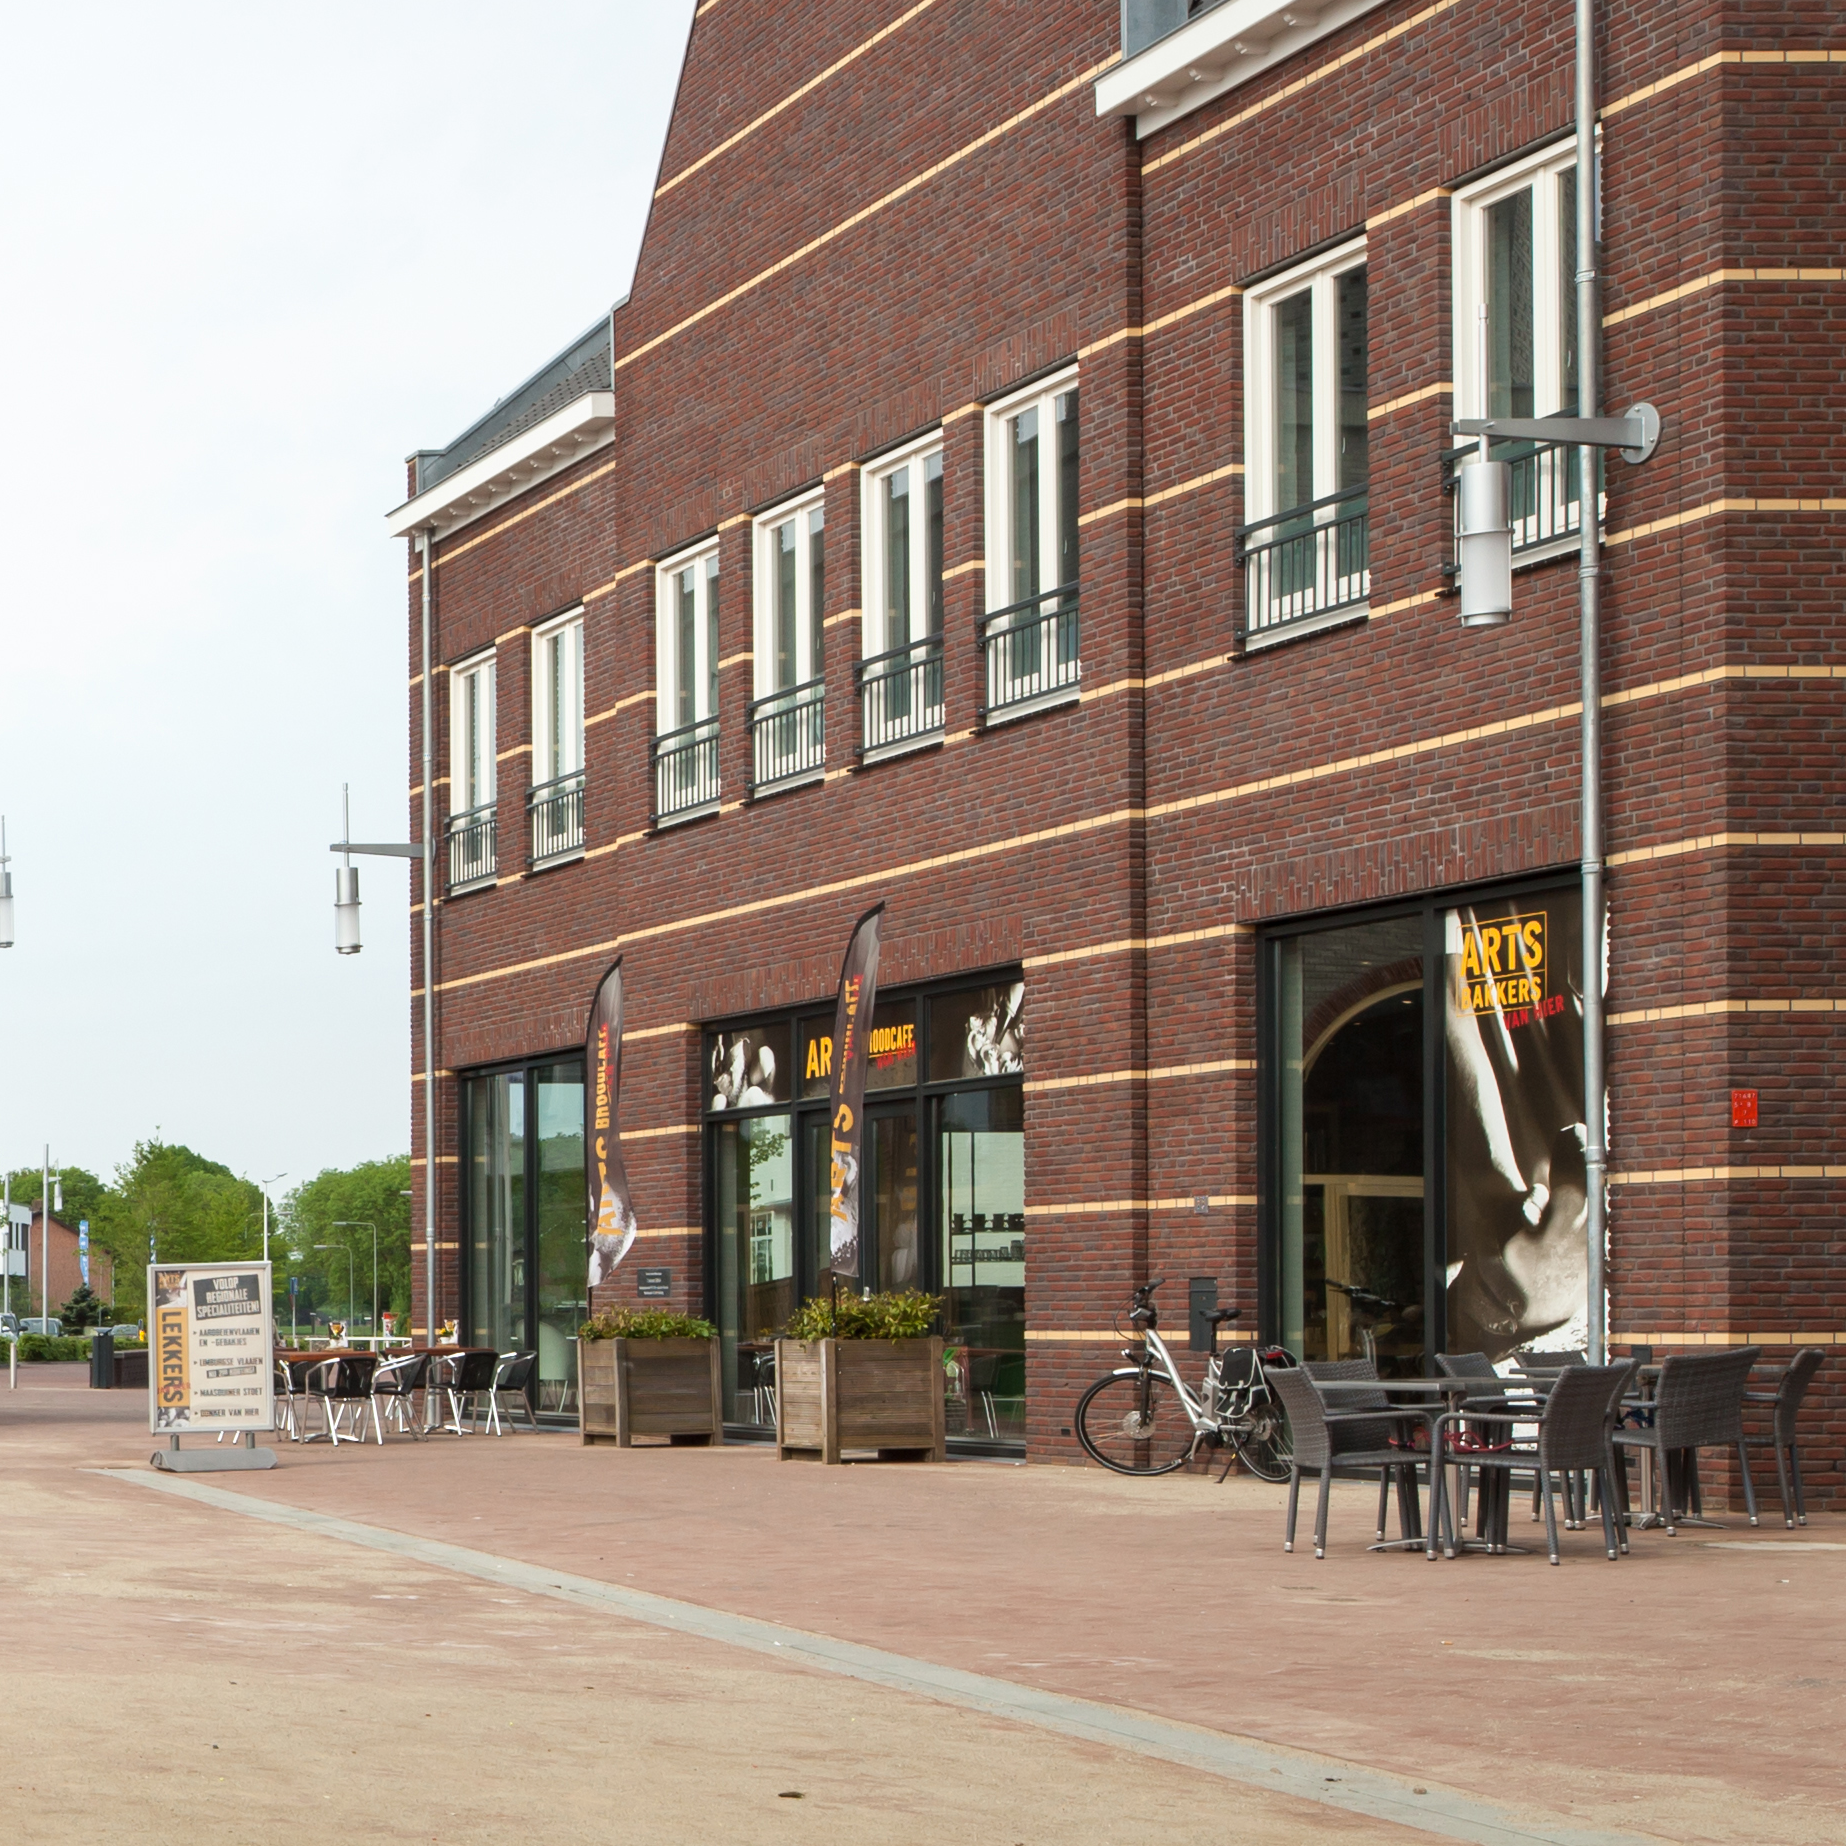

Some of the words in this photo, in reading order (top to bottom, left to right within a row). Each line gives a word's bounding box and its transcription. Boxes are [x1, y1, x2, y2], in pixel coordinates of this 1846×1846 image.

[1460, 920, 1543, 977] ARTS
[1461, 976, 1542, 1011] BAKKERS
[1503, 1009, 1530, 1031] VAN
[1533, 994, 1565, 1021] HIER
[806, 1036, 831, 1079] AR
[868, 1024, 915, 1053] OODCAFE
[206, 1288, 248, 1303] REGIONALE
[212, 1277, 239, 1290] VOLOP
[162, 1311, 183, 1403] LEKKERS
[199, 1339, 208, 1347] EN
[228, 1408, 242, 1417] VAN
